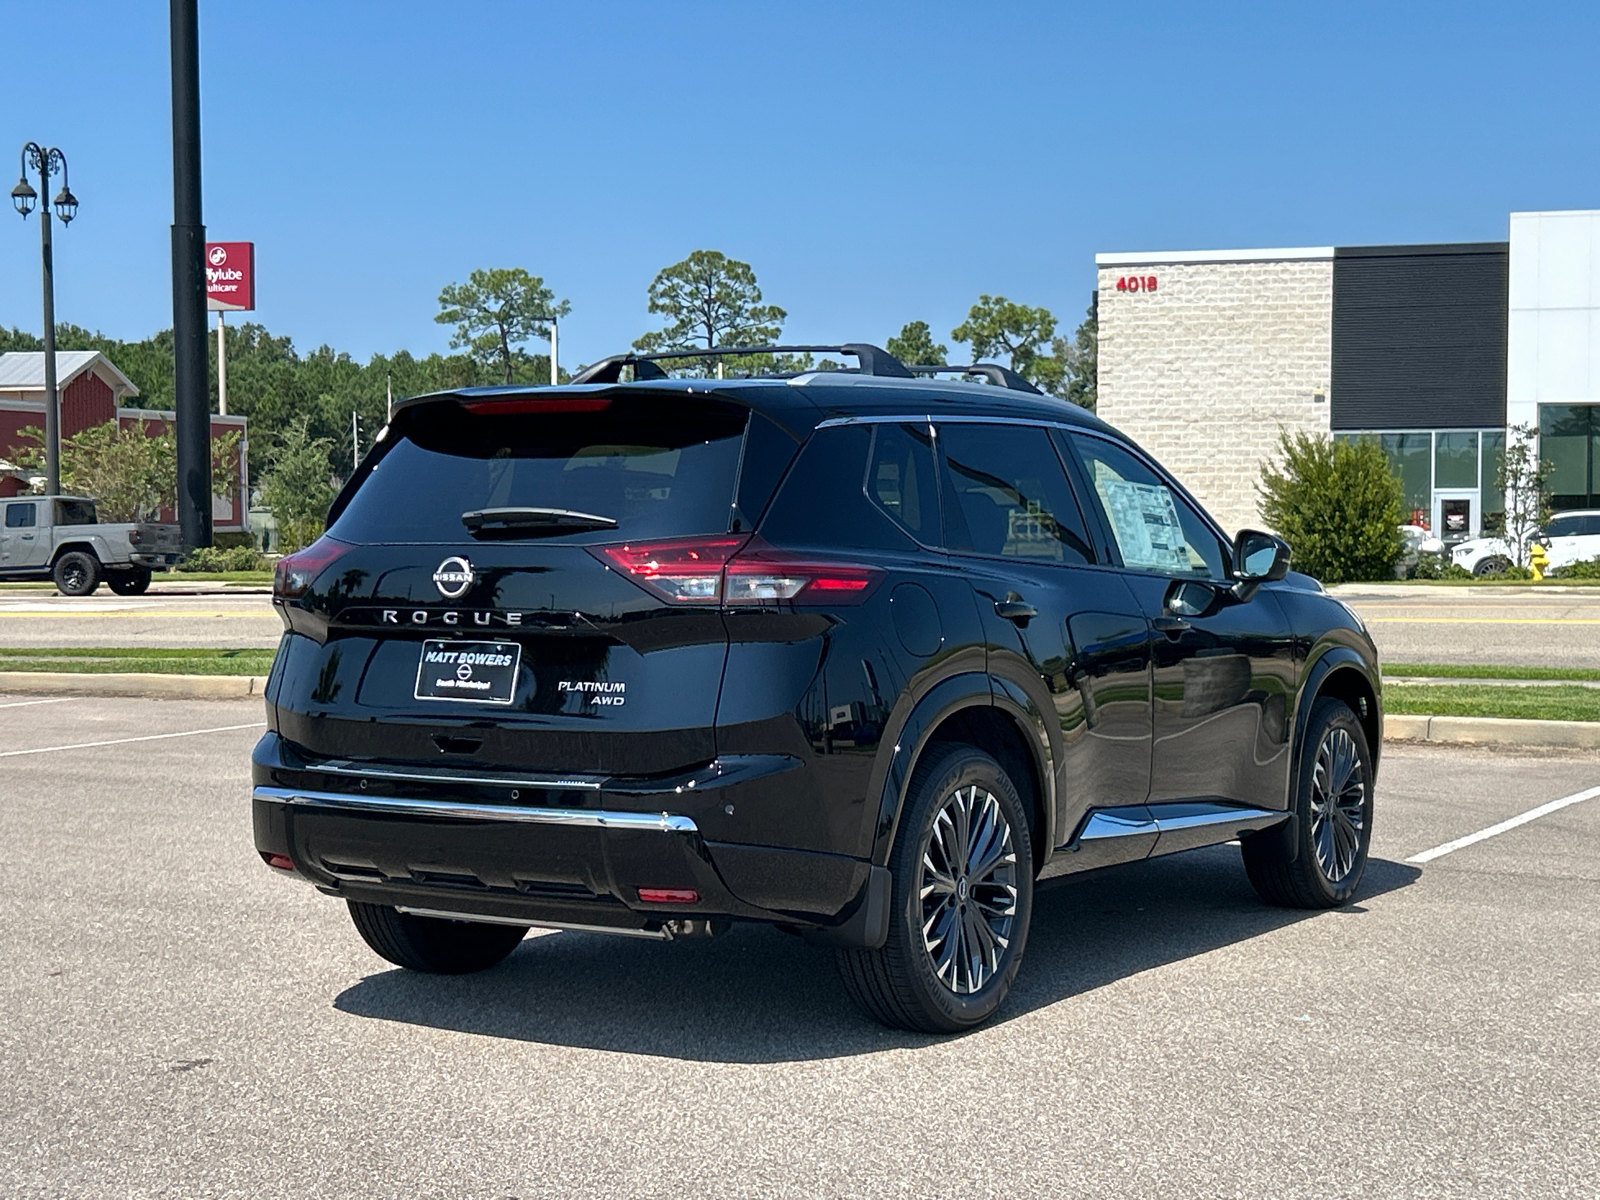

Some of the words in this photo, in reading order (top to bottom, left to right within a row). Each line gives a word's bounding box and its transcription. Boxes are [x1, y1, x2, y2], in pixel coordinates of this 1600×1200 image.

[207, 283, 238, 293] ulticare
[1116, 276, 1158, 293] 4018
[432, 572, 474, 582] NISSAN
[383, 609, 522, 626] ROGUE
[425, 651, 458, 664] MATT
[457, 652, 513, 666] BOWERS
[557, 681, 626, 693] PLATINUM
[590, 696, 625, 706] AWD
